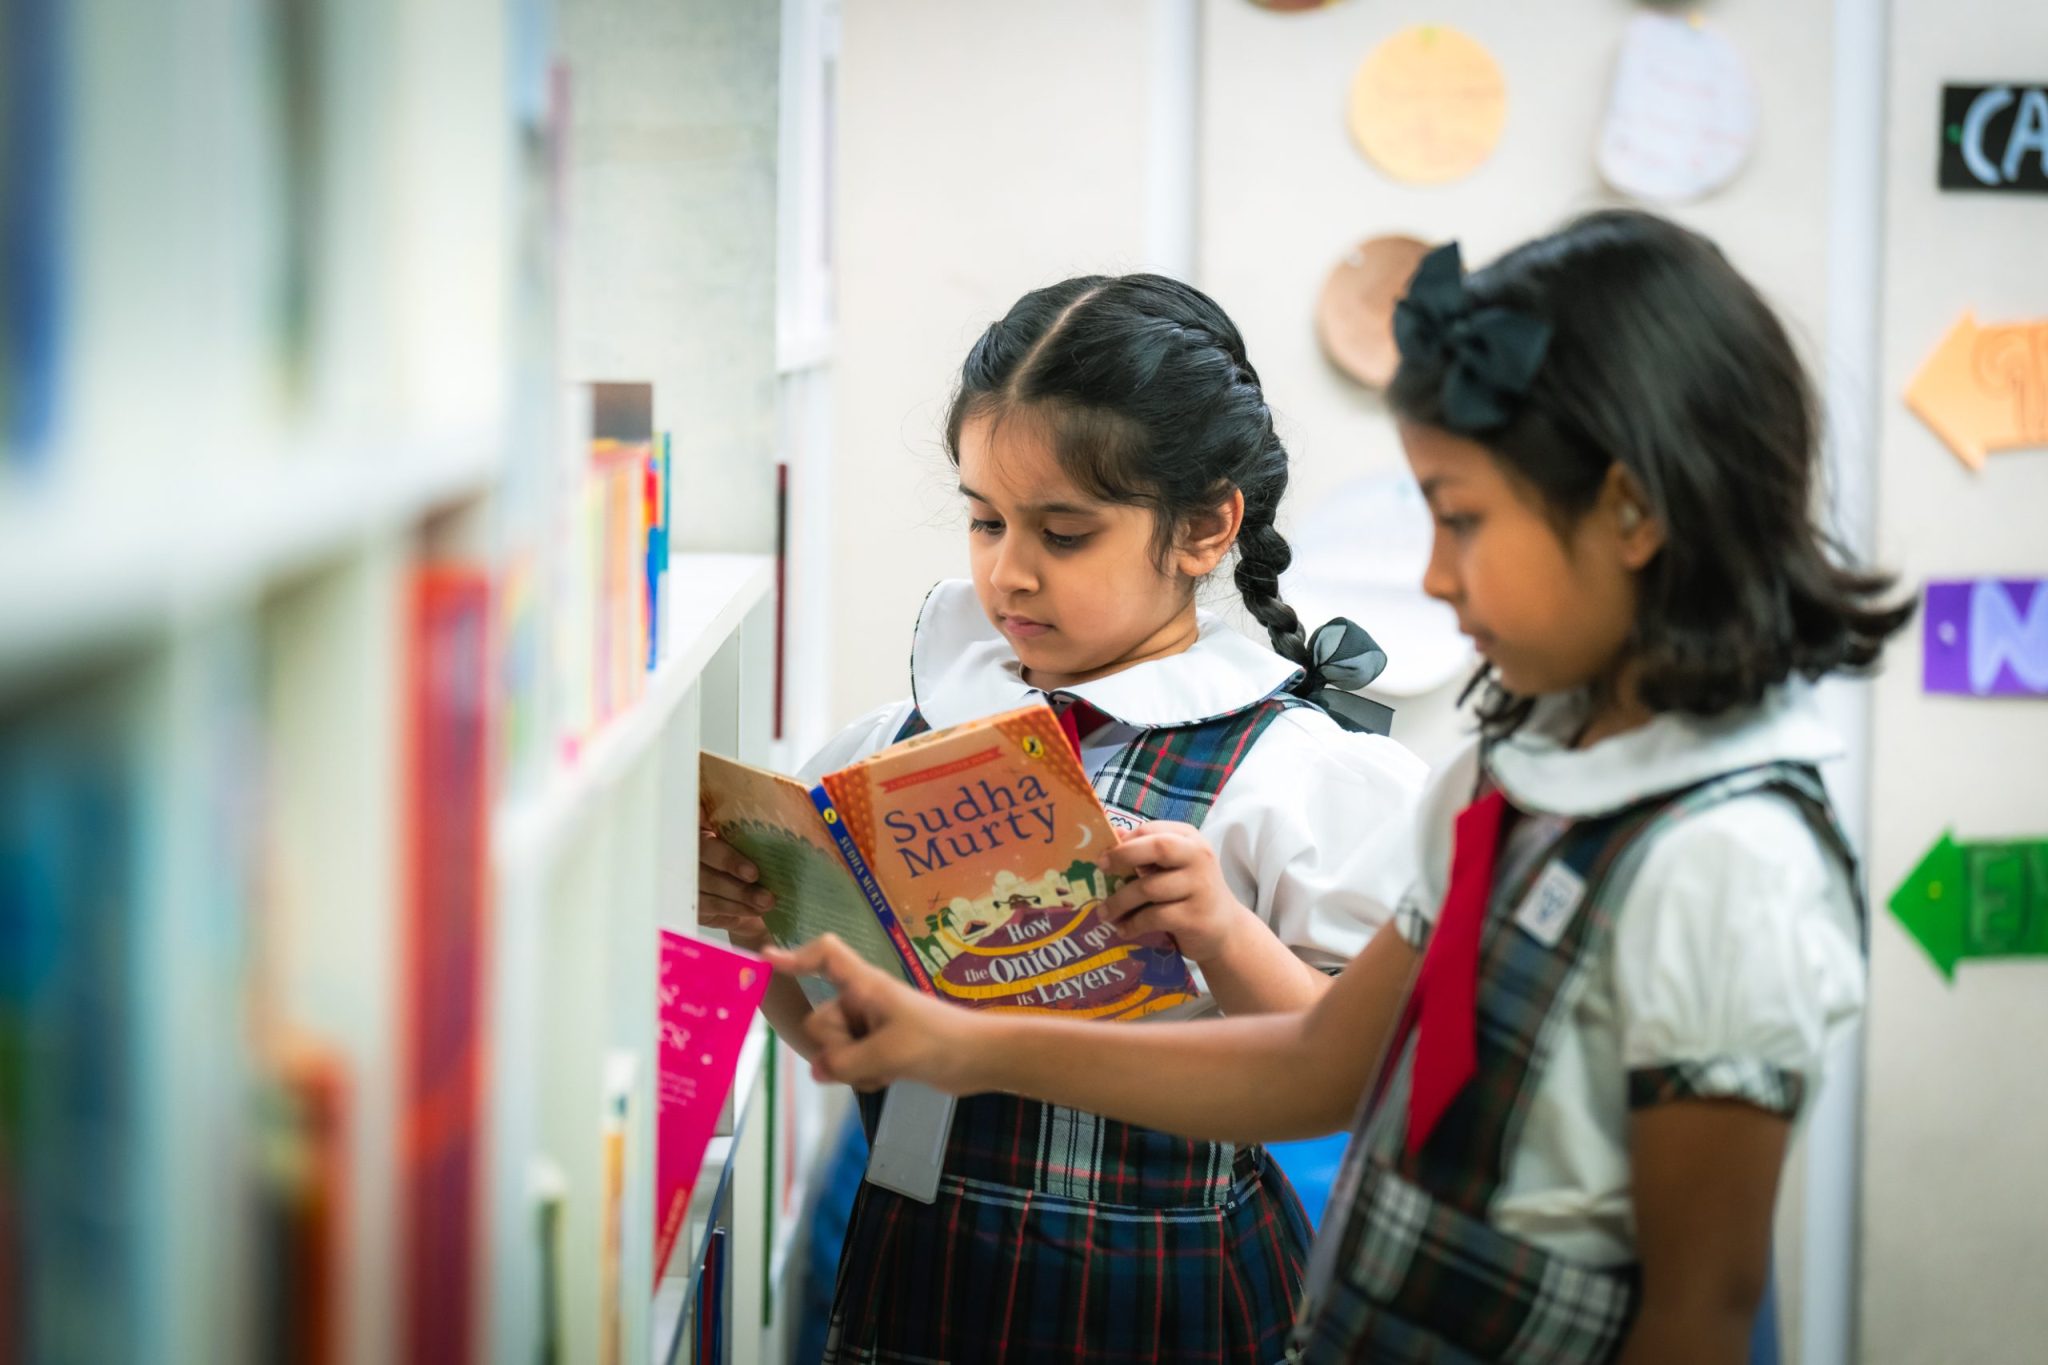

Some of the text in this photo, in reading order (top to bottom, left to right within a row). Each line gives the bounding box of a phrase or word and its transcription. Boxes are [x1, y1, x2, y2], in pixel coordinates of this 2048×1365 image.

[884, 775, 1049, 843] Sudha
[896, 802, 1056, 878] Murty
[839, 836, 888, 914] SUDHA MURTY
[1006, 917, 1052, 944] How
[964, 967, 988, 983] the
[1033, 964, 1126, 1004] Layers
